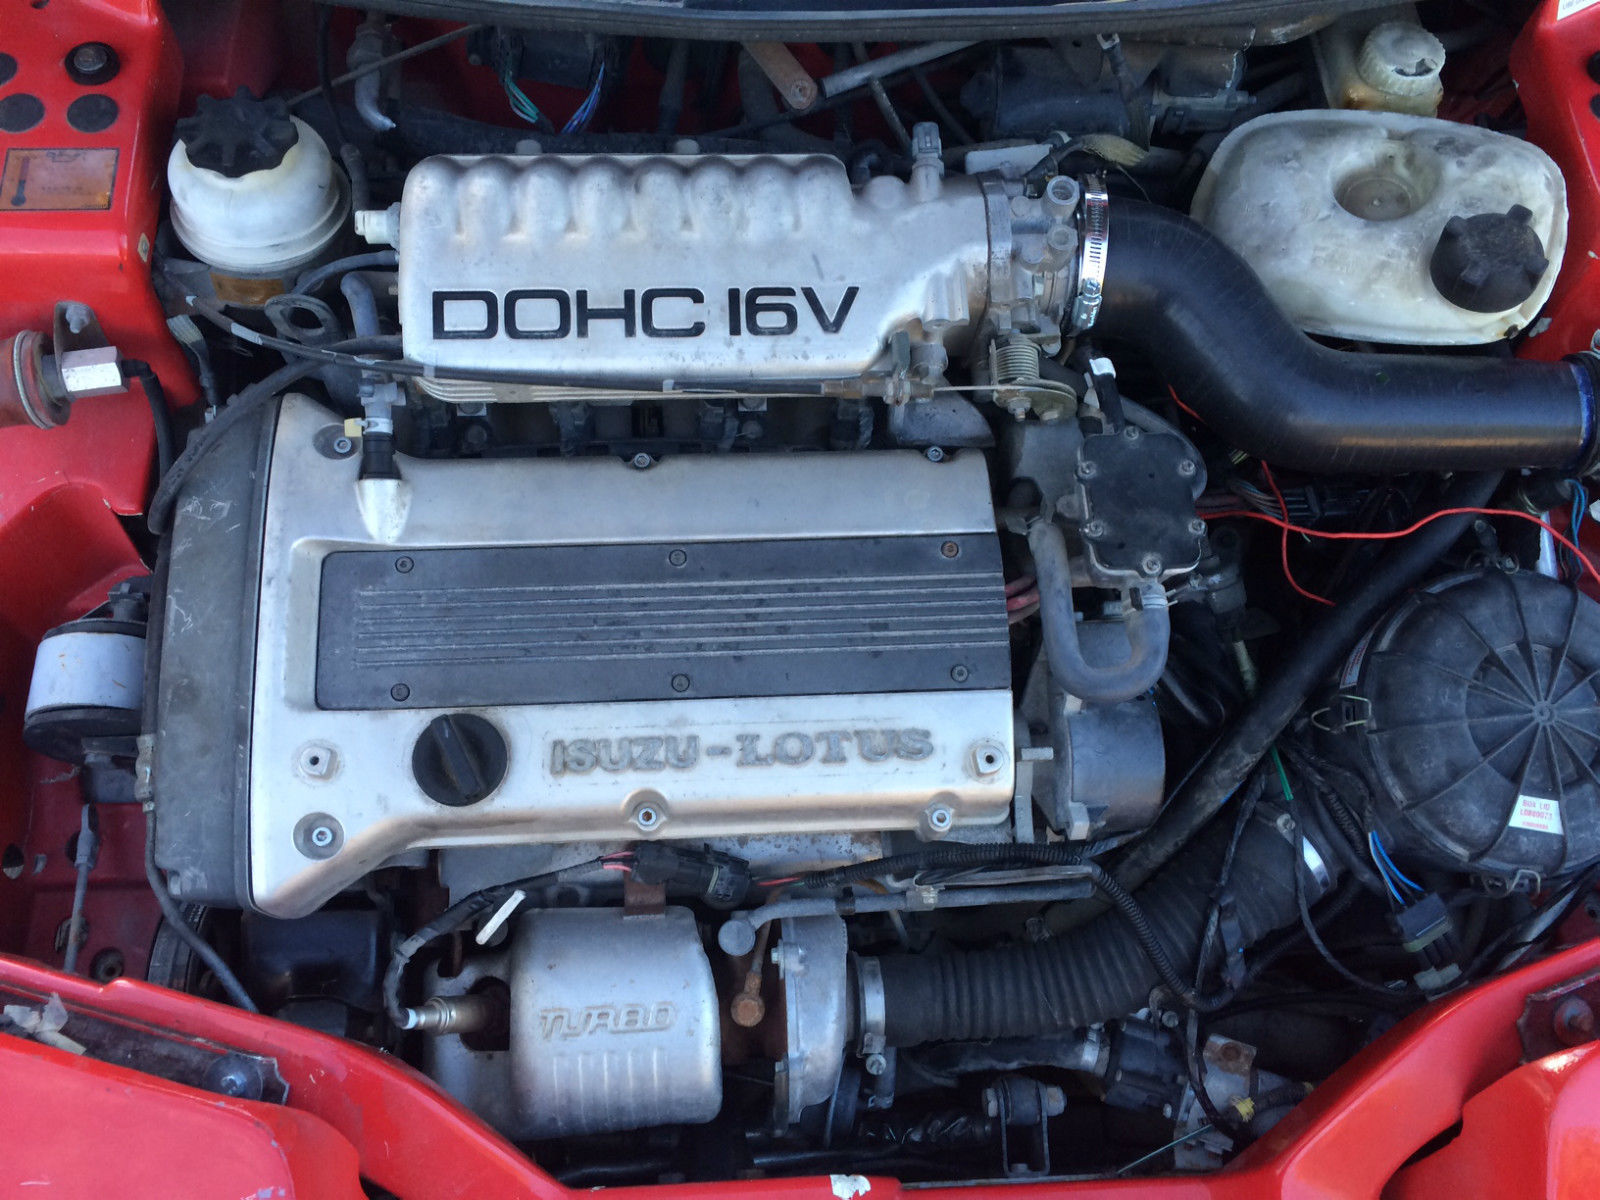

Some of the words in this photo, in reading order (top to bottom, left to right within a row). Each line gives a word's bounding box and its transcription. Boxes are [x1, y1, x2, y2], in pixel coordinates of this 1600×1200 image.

[432, 287, 706, 340] DOHC
[727, 286, 860, 337] 16V
[540, 1001, 677, 1041] TURBO
